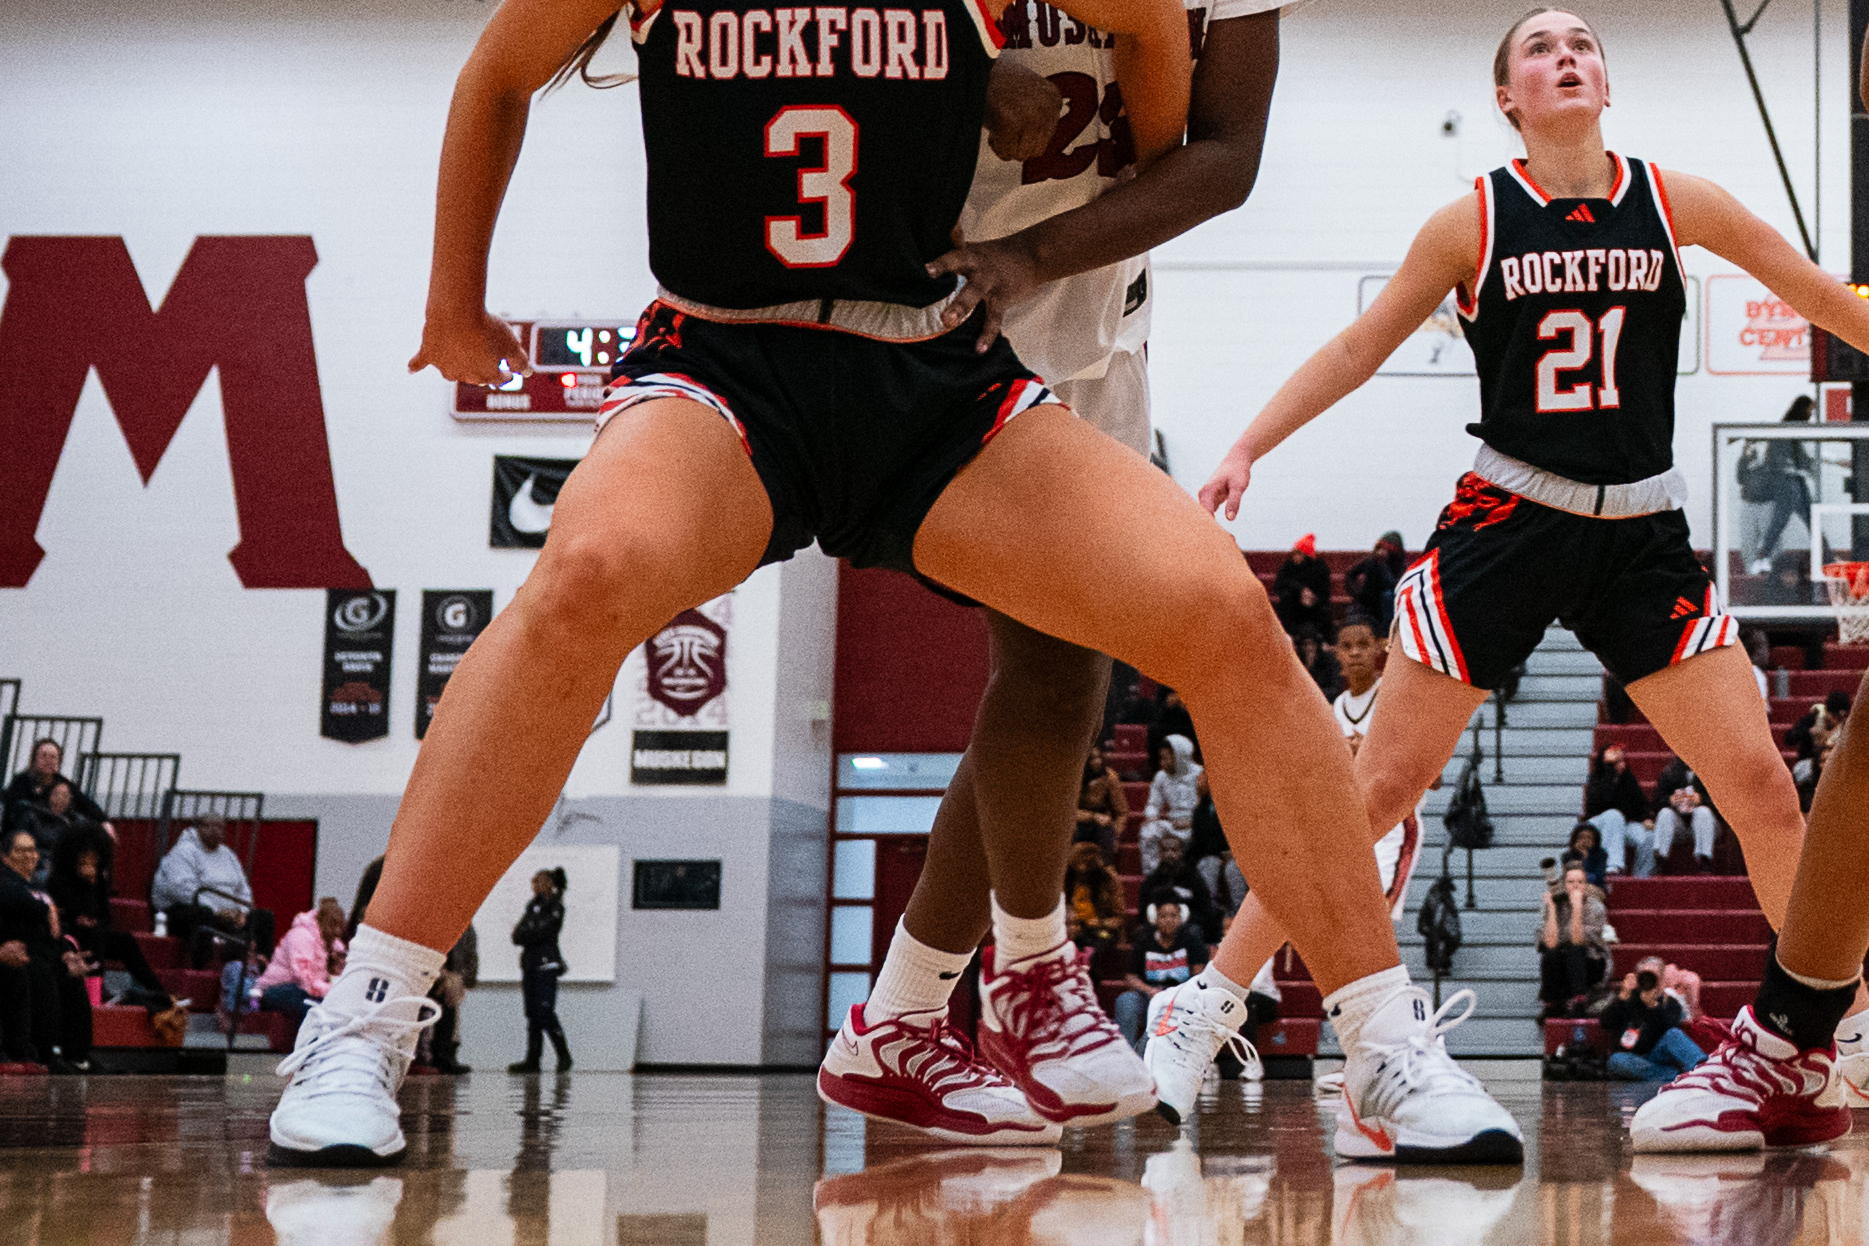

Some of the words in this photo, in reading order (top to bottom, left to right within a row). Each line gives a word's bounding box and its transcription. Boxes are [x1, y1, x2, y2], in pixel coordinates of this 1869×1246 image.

[673, 6, 949, 80] ROCKFORD
[764, 105, 859, 268] 3
[1501, 249, 1664, 300] ROCKFORD
[0, 235, 374, 588] M
[1535, 306, 1627, 413] 21
